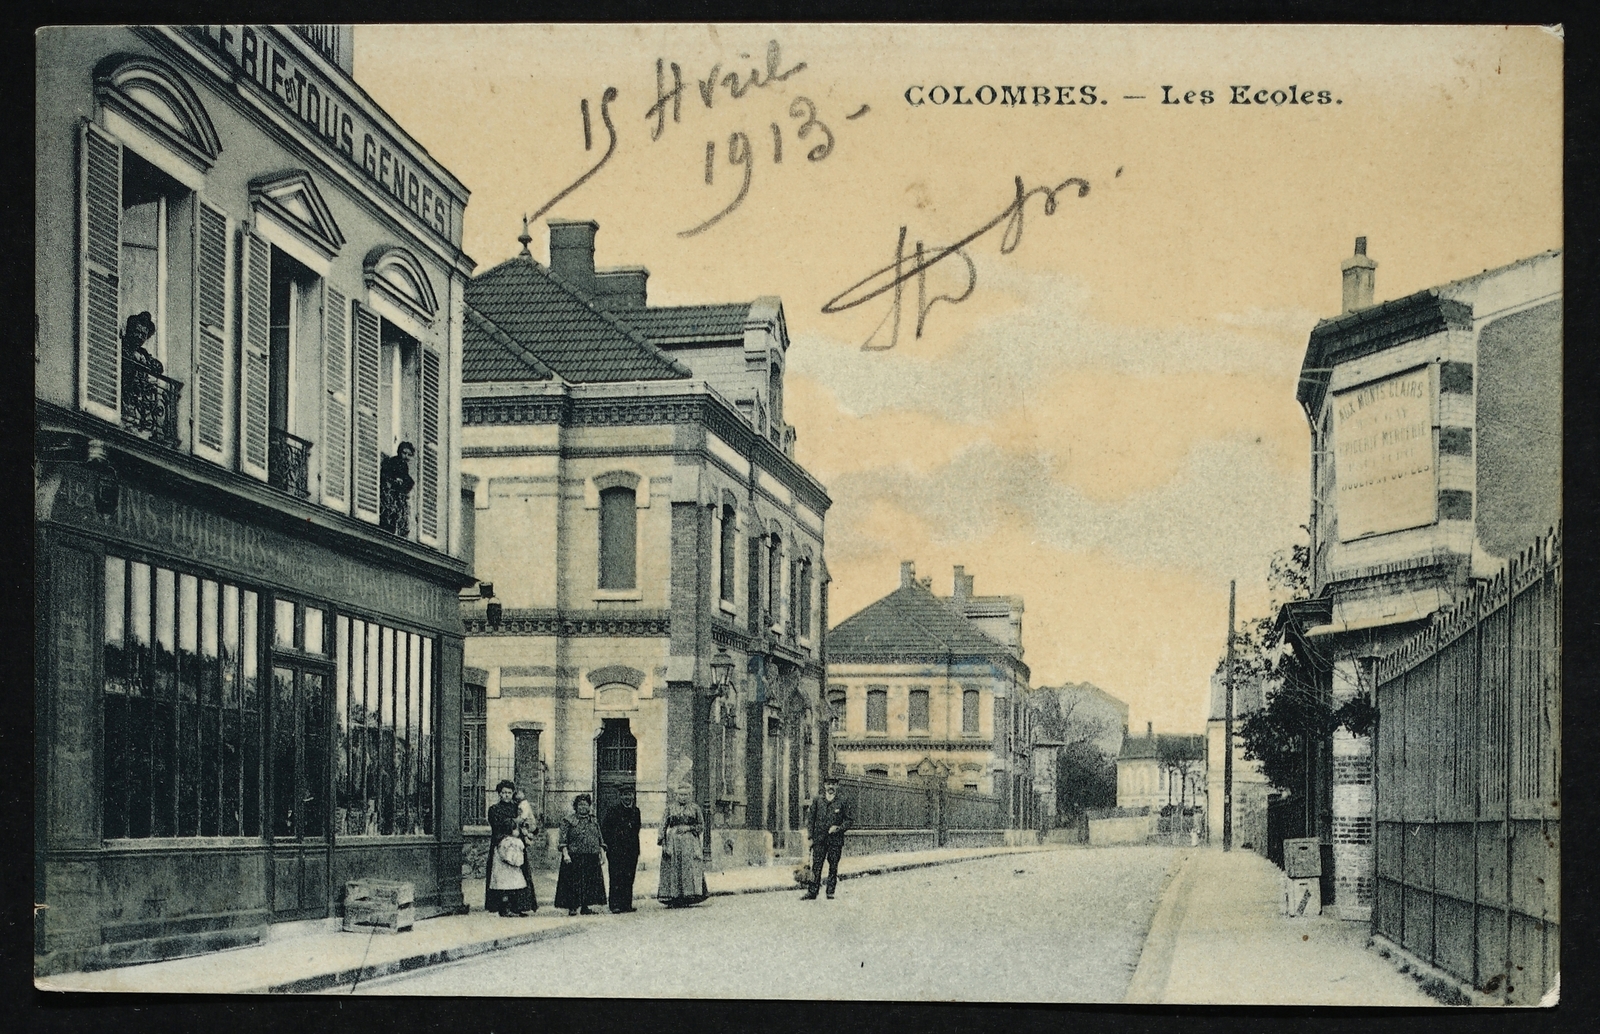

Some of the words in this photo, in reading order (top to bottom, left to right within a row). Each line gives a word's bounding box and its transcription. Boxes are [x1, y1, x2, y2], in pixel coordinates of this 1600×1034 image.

[284, 76, 298, 104] en
[294, 67, 354, 157] TOUS
[363, 132, 446, 234] GENRES
